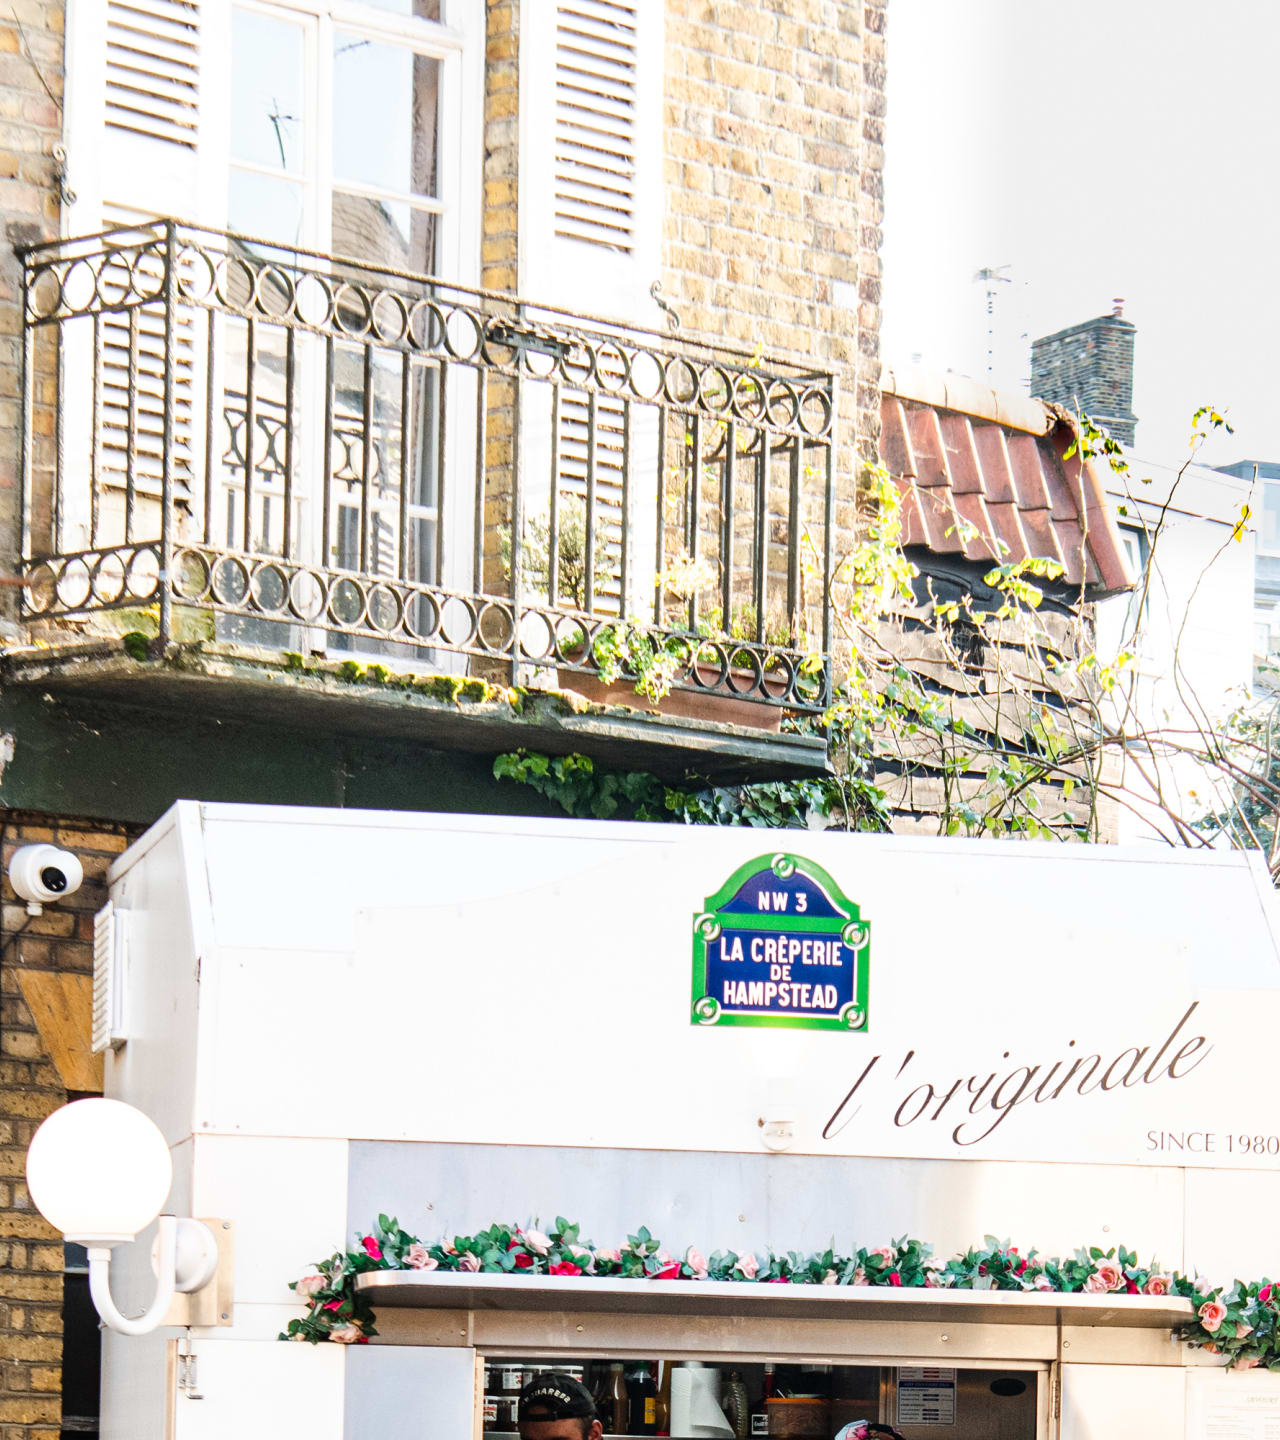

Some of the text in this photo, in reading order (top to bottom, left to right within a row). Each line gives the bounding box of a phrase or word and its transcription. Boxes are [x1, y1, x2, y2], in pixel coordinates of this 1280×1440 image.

[758, 891, 807, 912] NW 3
[720, 935, 843, 966] LA CRÊPERIE
[770, 964, 792, 981] DE
[723, 980, 838, 1009] HAMPSTEAD
[822, 1001, 1215, 1146] l'originale
[1147, 1130, 1280, 1156] SINCE 1980
